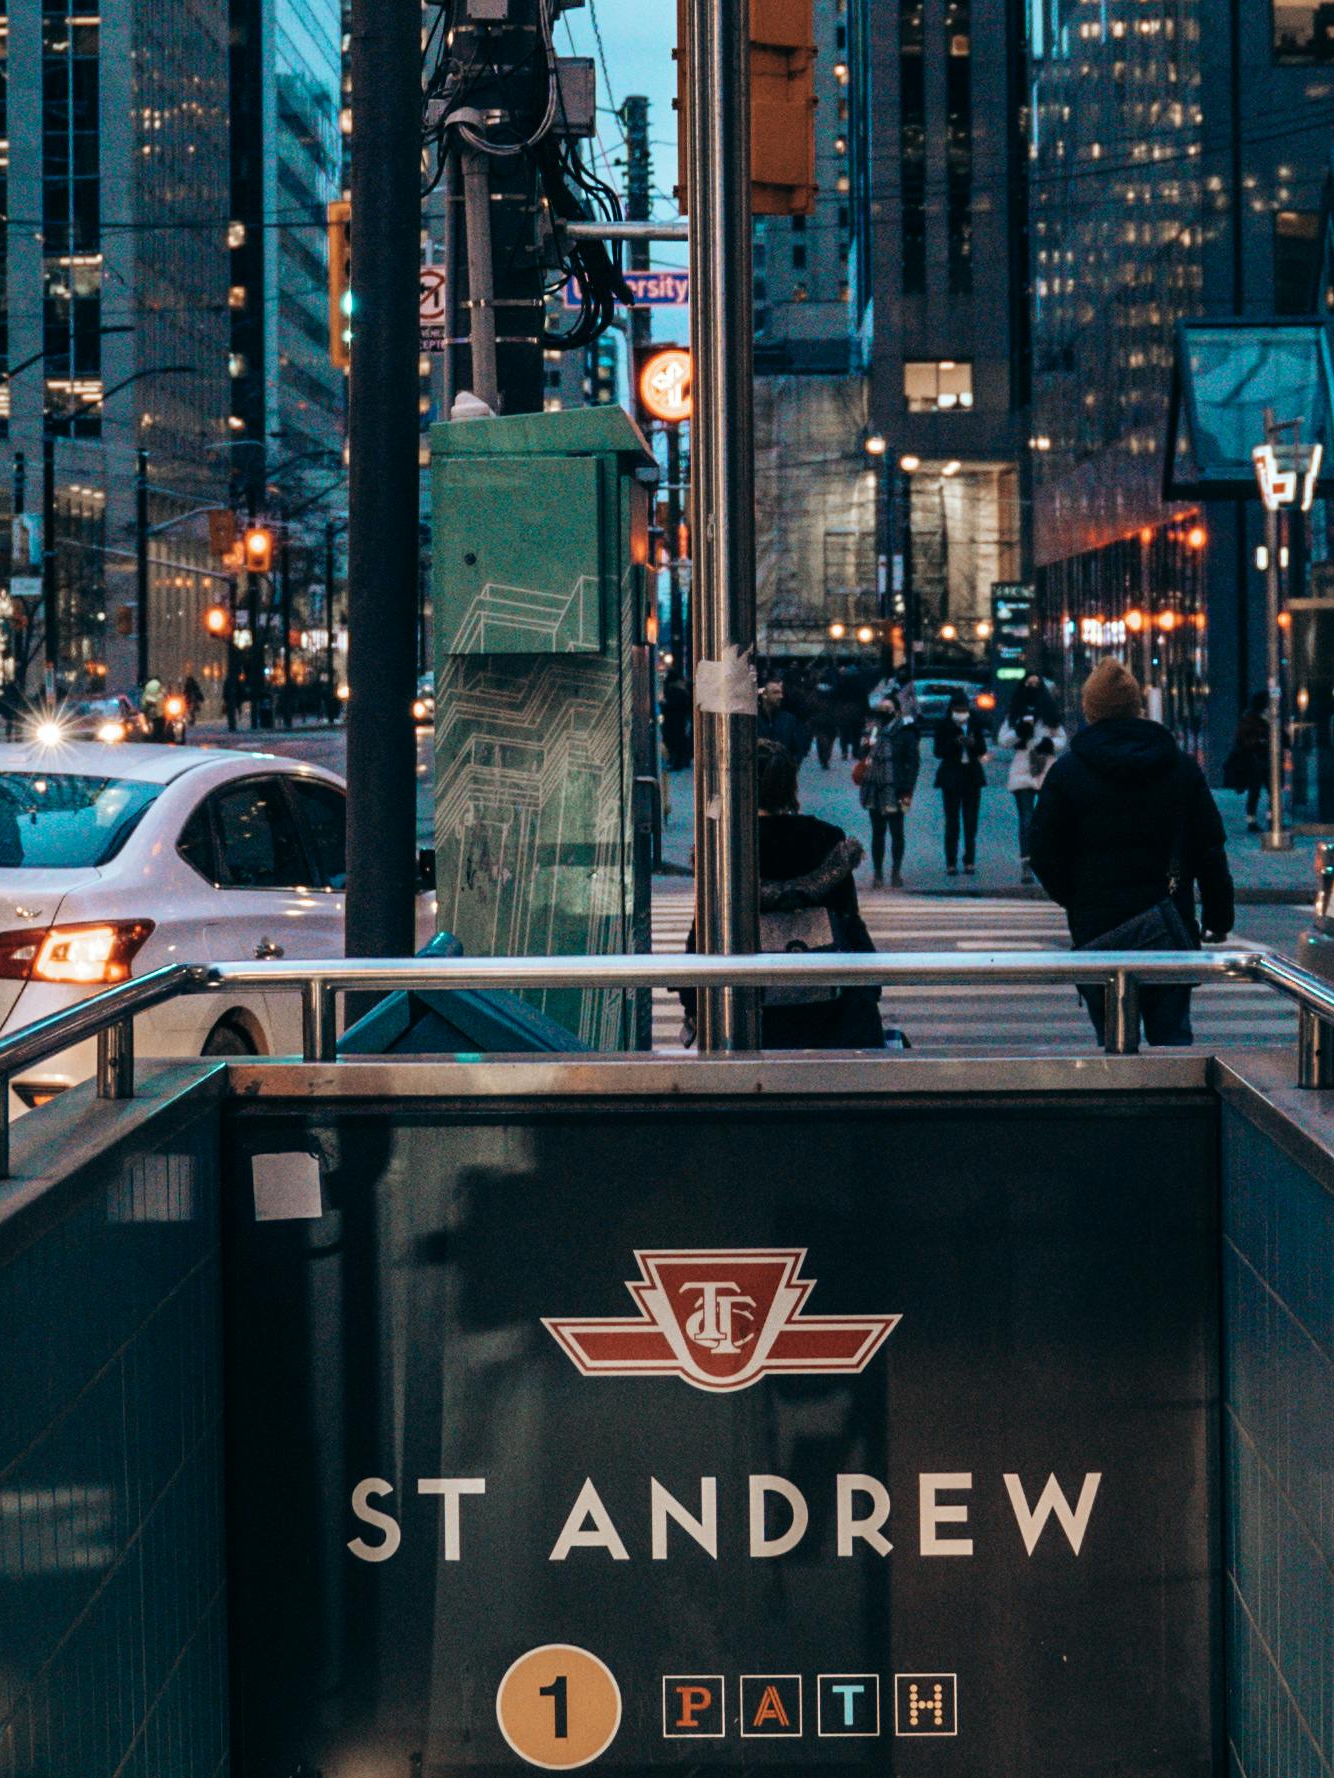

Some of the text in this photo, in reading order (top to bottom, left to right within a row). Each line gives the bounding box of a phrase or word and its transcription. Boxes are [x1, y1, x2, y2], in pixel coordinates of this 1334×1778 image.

[571, 274, 688, 303] Ursity
[347, 1471, 1102, 1562] ST ANDREW
[538, 1675, 569, 1739] 1
